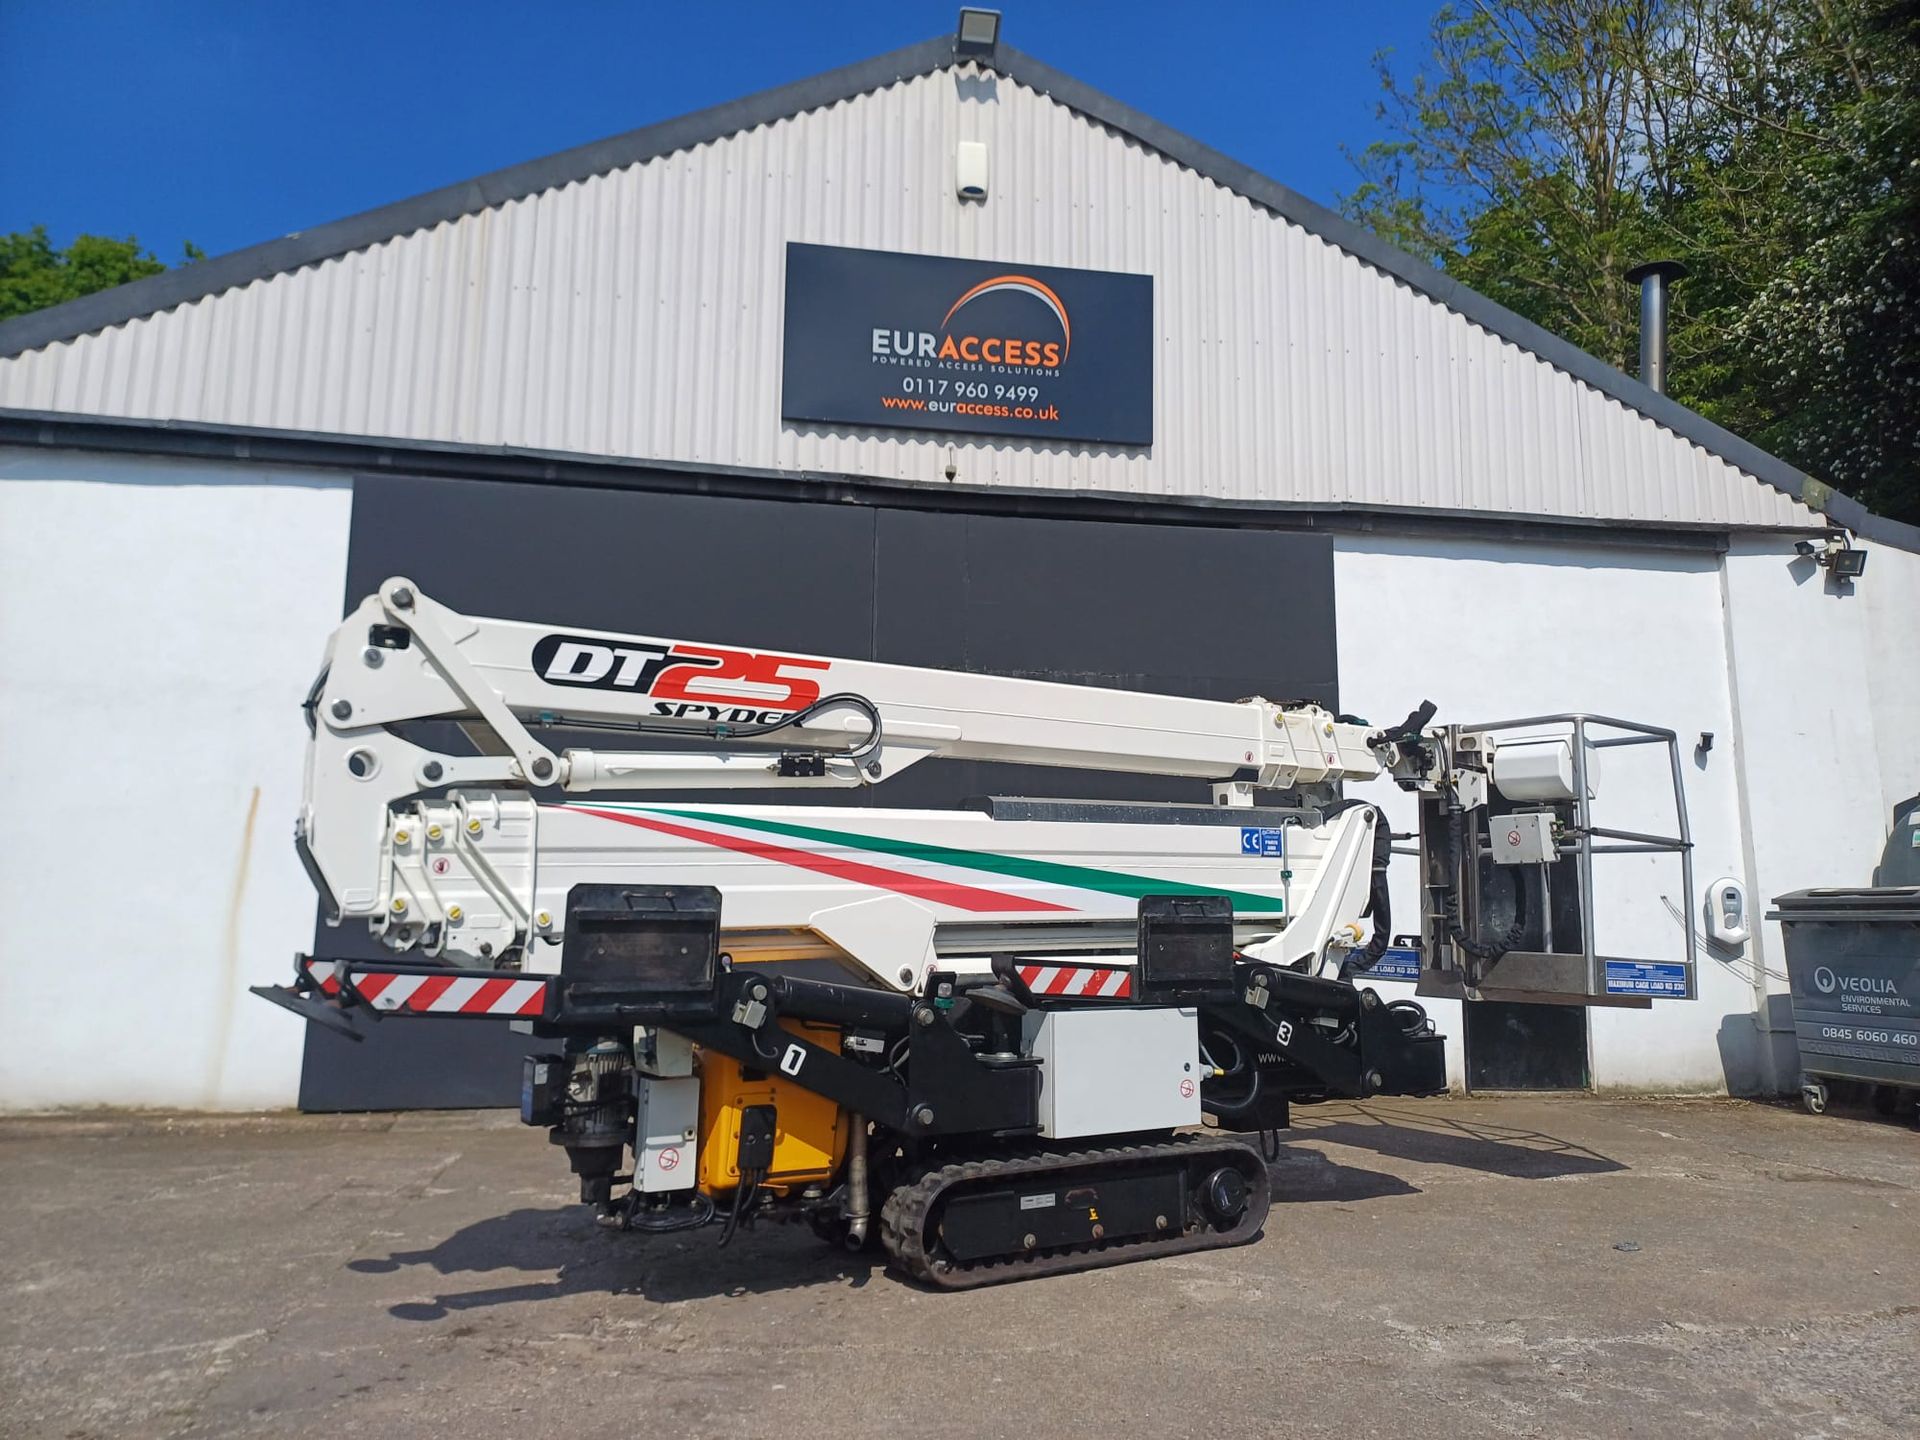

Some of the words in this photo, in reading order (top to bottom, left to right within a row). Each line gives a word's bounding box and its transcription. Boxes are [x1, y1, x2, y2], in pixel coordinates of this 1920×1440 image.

[872, 328, 1060, 368] EURACCESS
[872, 355, 931, 368] POWERED
[938, 361, 983, 372] ACCESS
[991, 366, 1060, 377] SOLUTIONS
[902, 377, 948, 395] 0117
[954, 381, 988, 399] 960
[994, 384, 1039, 402] 9499
[881, 396, 1059, 421] www.euraccess.co.uk
[1838, 976, 1898, 994] VEOLIA
[1841, 995, 1912, 1007] ENVIRONMENTAL
[1842, 1003, 1882, 1014] SERVICES
[1279, 1024, 1291, 1042] 3
[1822, 1027, 1852, 1040] 0845
[1856, 1030, 1888, 1043] 6060
[1892, 1034, 1917, 1046] 460
[788, 1049, 802, 1070] 1
